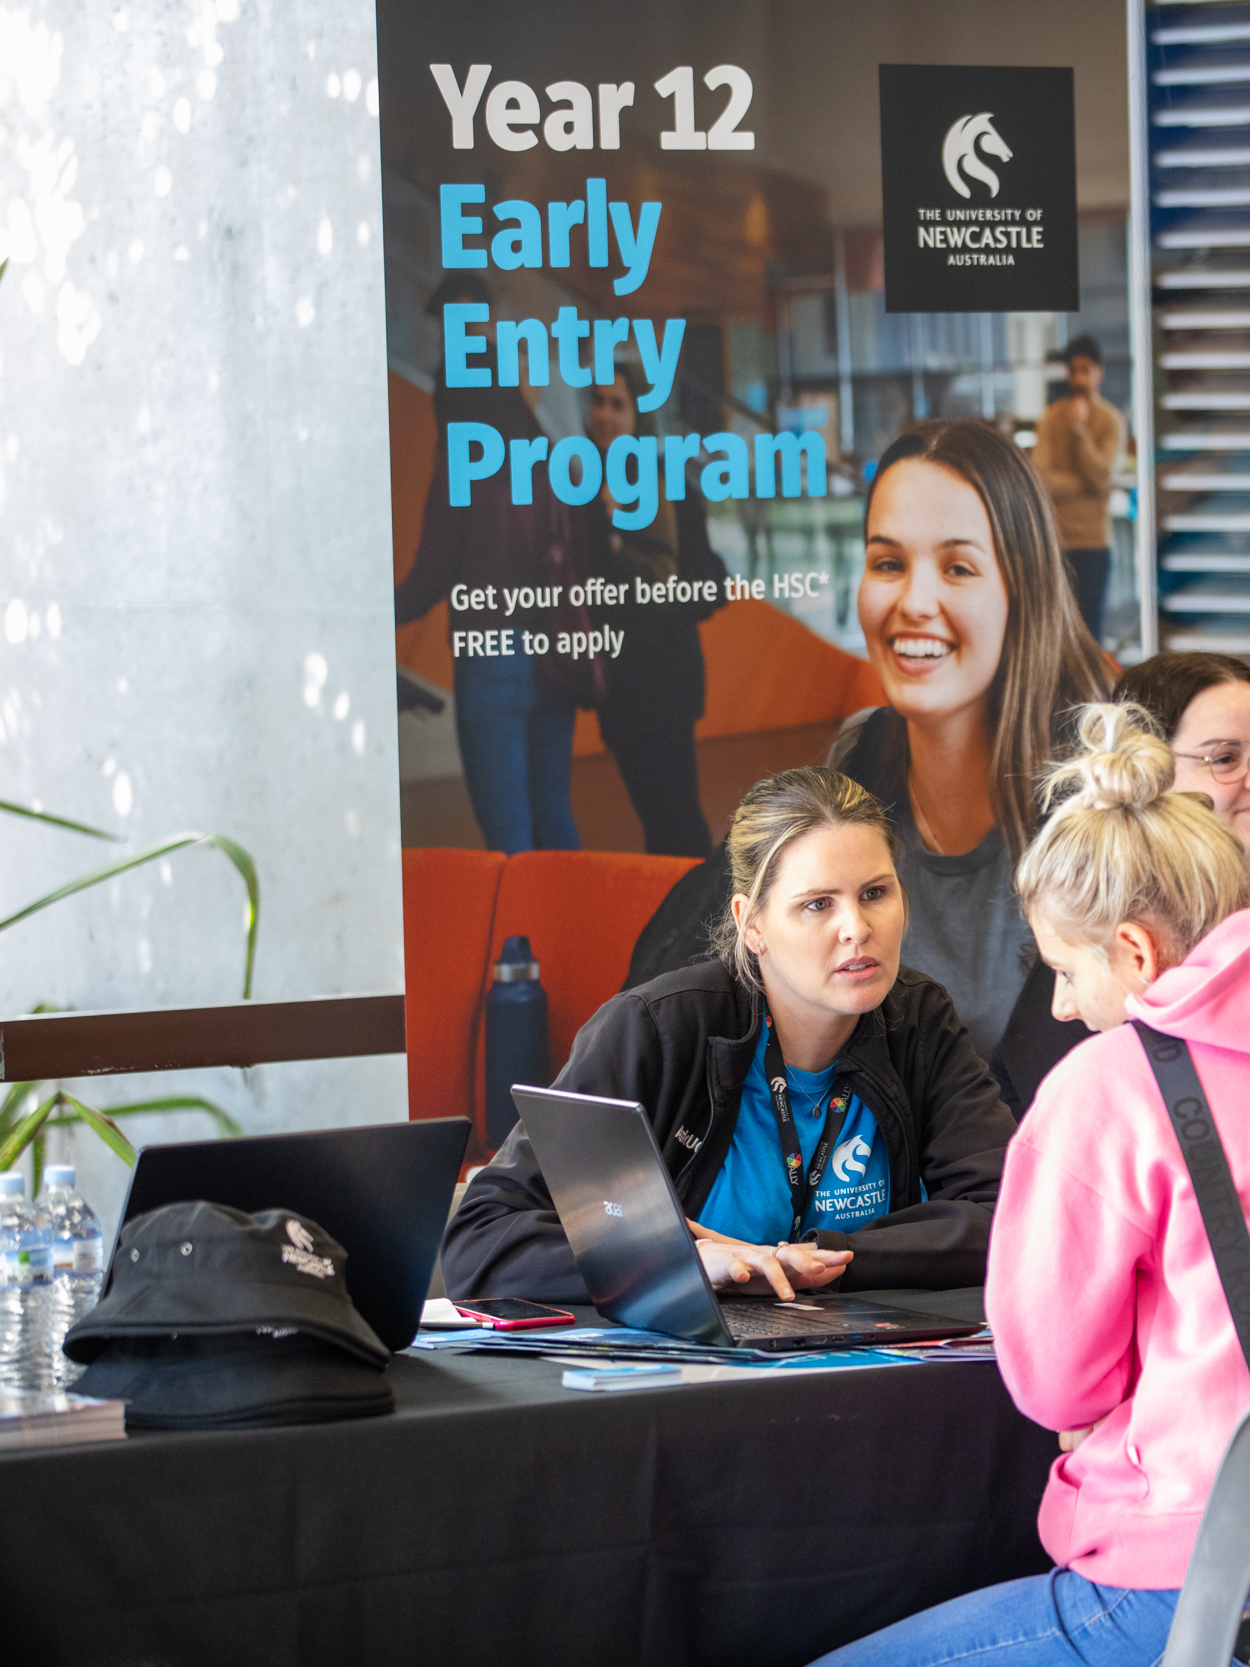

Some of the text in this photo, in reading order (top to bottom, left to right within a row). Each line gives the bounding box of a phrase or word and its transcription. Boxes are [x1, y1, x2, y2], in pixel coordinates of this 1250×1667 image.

[430, 63, 756, 152] Year 12
[918, 208, 1043, 221] THE UNIVERSITY OF
[440, 178, 663, 297] Early
[918, 226, 1044, 249] NEWCASTLE
[947, 253, 1015, 266] AUSTRALIA
[443, 303, 687, 414] Entry
[447, 422, 827, 531] Program
[451, 583, 498, 611] Get
[503, 586, 563, 617] your
[569, 577, 630, 607] offer
[635, 574, 718, 605] before
[723, 574, 768, 600] the
[453, 624, 625, 660] FREE to apply
[787, 1165, 799, 1186] ALLY
[1173, 1096, 1247, 1259] COUNTRY
[814, 1188, 886, 1212] NEWCASTLE
[815, 1190, 831, 1198] THE
[834, 1182, 877, 1196] UNIVERSITY
[603, 1200, 623, 1217] acer
[835, 1207, 875, 1220] AUSTRALIA
